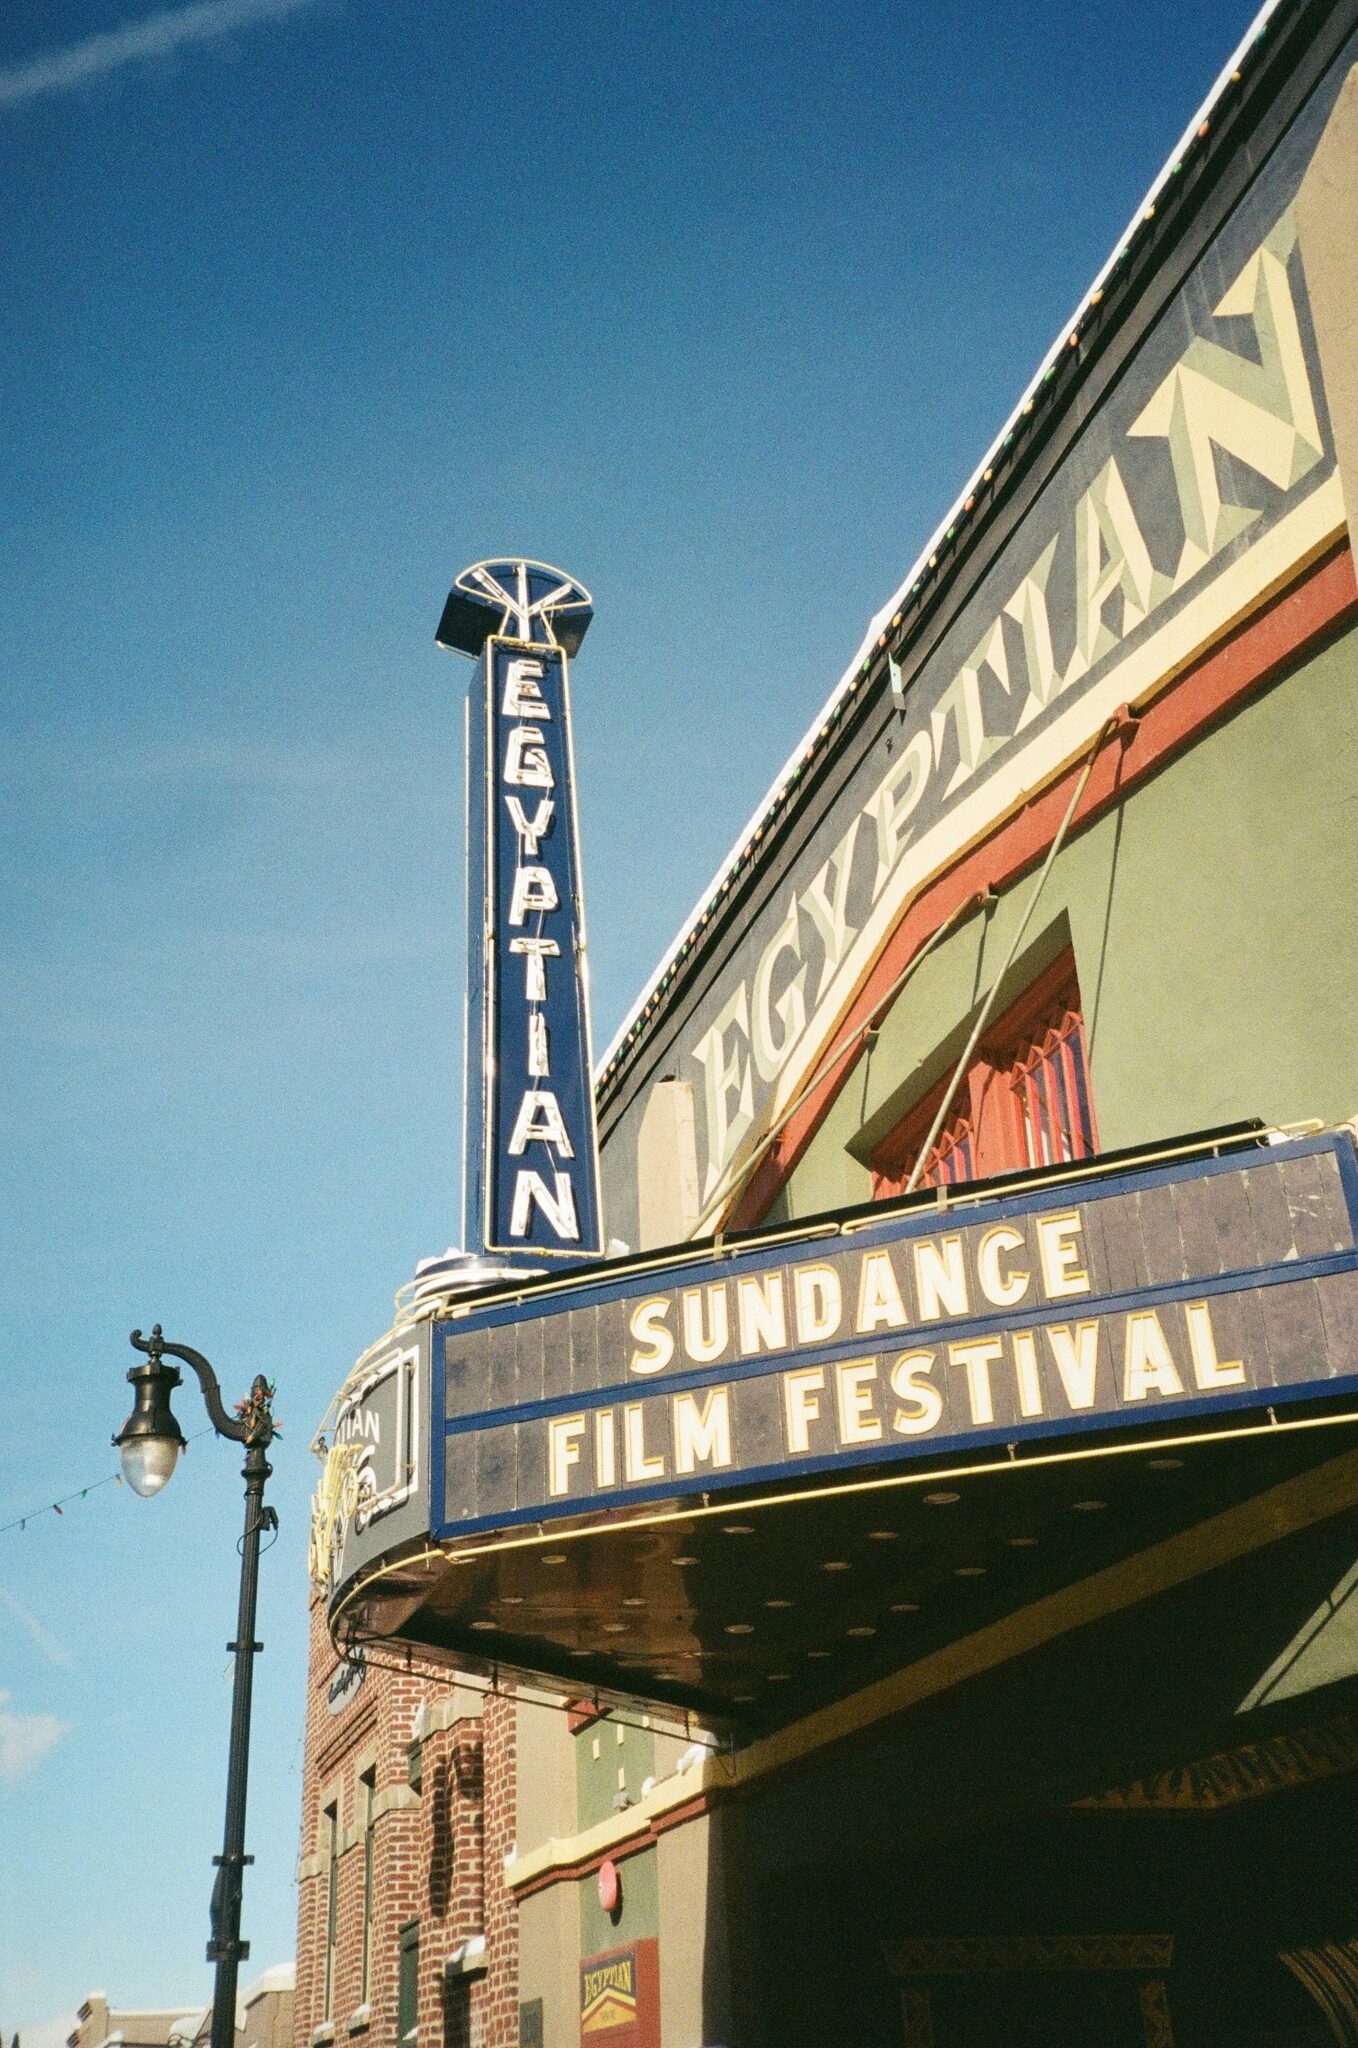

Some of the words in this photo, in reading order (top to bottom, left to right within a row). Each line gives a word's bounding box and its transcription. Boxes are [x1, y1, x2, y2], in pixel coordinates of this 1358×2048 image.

[692, 200, 1324, 1207] EGYPTIAN
[502, 658, 579, 1240] EGYPTIAN
[629, 1210, 1091, 1375] SUNDANCE
[548, 1386, 733, 1497] FILM
[784, 1300, 1246, 1454] FESTIVAL
[584, 1961, 632, 2006] EGYPTIAN
